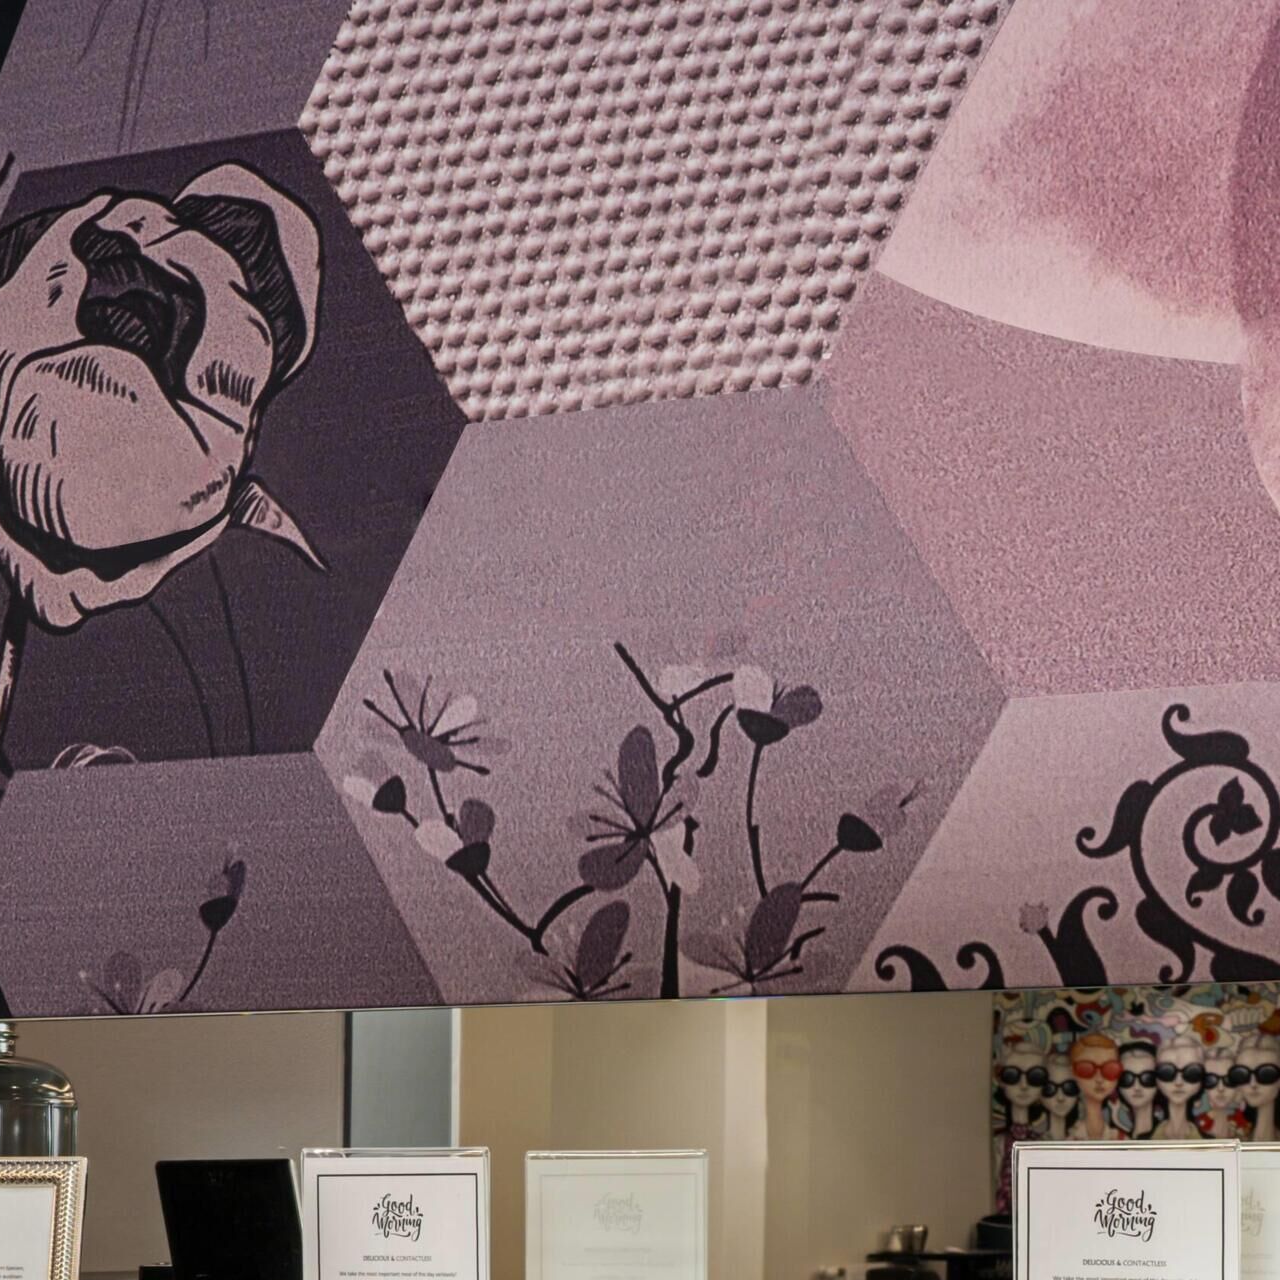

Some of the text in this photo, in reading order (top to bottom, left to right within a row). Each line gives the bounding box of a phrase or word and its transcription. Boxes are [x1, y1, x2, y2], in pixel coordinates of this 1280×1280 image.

[382, 1193, 414, 1217] Good
[1105, 1189, 1146, 1215] Good
[372, 1212, 422, 1242] Morning
[1094, 1209, 1156, 1242] Morning
